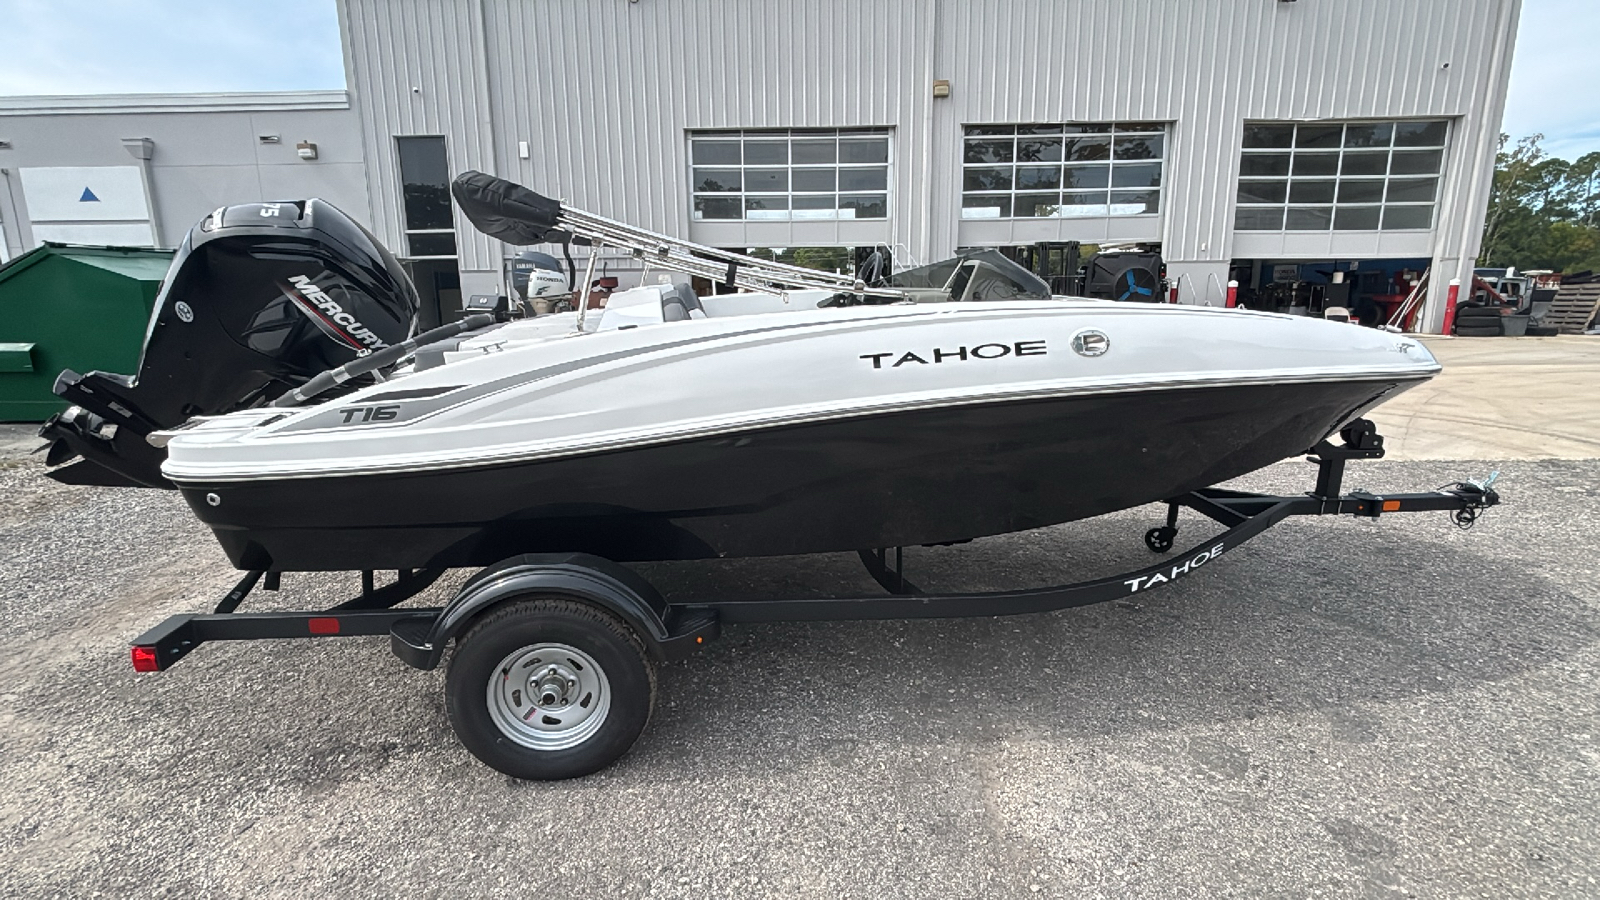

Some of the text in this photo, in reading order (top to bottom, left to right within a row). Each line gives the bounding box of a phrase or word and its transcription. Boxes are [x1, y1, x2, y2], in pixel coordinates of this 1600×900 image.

[259, 203, 281, 218] 75
[536, 276, 564, 284] HONDA
[287, 275, 391, 349] MERCURY
[859, 340, 1047, 369] TAHOE
[339, 405, 401, 424] T16
[1123, 542, 1224, 592] TAHOE
